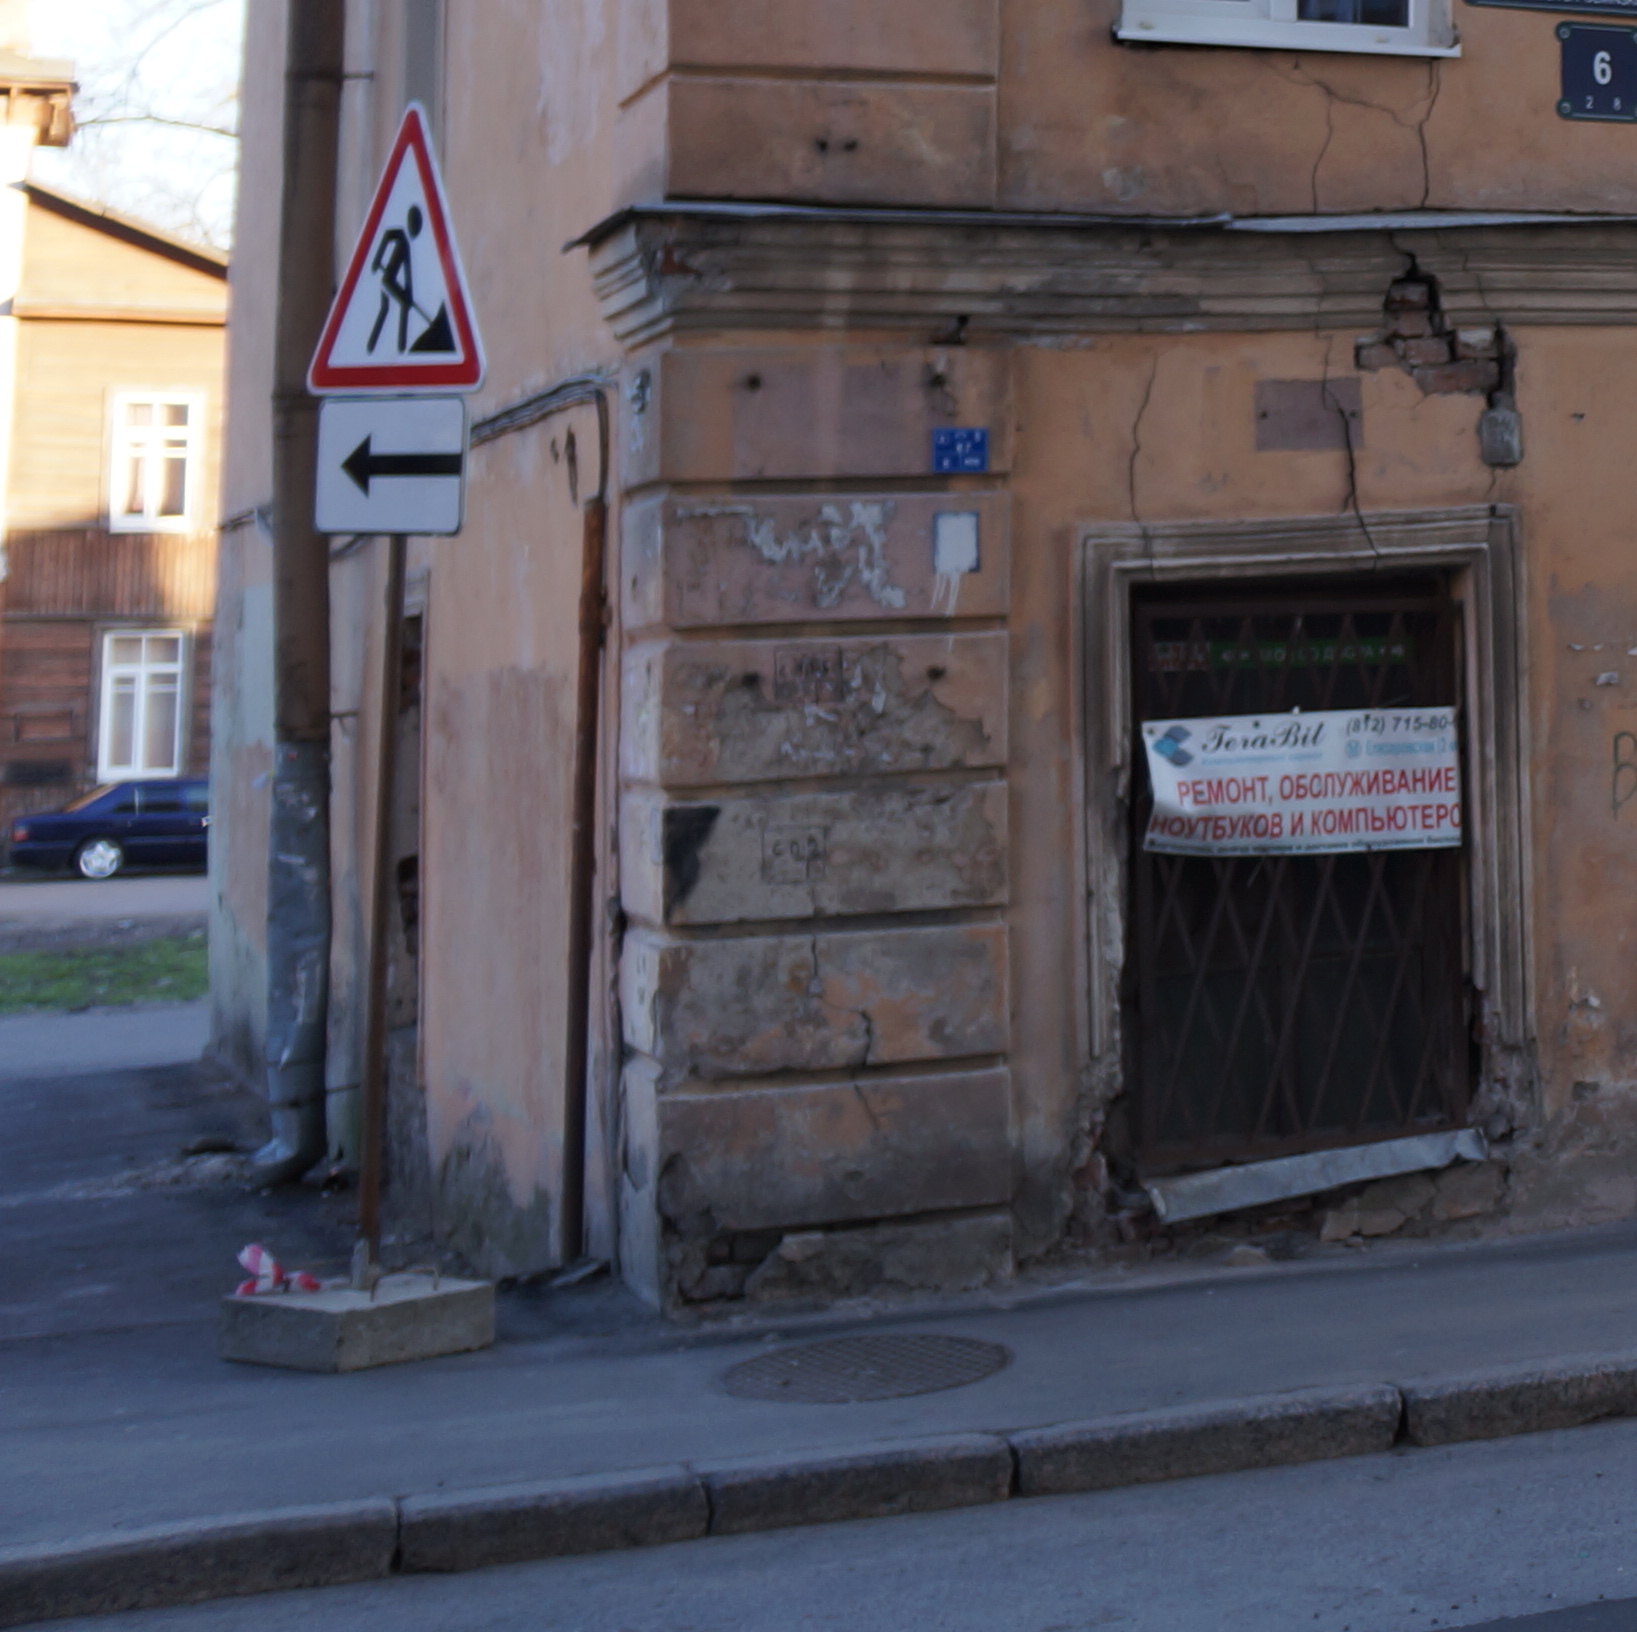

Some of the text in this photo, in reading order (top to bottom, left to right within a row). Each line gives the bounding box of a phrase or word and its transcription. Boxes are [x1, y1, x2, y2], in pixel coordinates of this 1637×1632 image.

[1593, 51, 1612, 85] 6
[1585, 95, 1594, 109] 2
[1177, 767, 1456, 808] РЕМОНТ, ОБСЛУЖИВАНИЕ
[1150, 812, 1284, 841] НОУТБУКОВ
[1290, 811, 1304, 837] И
